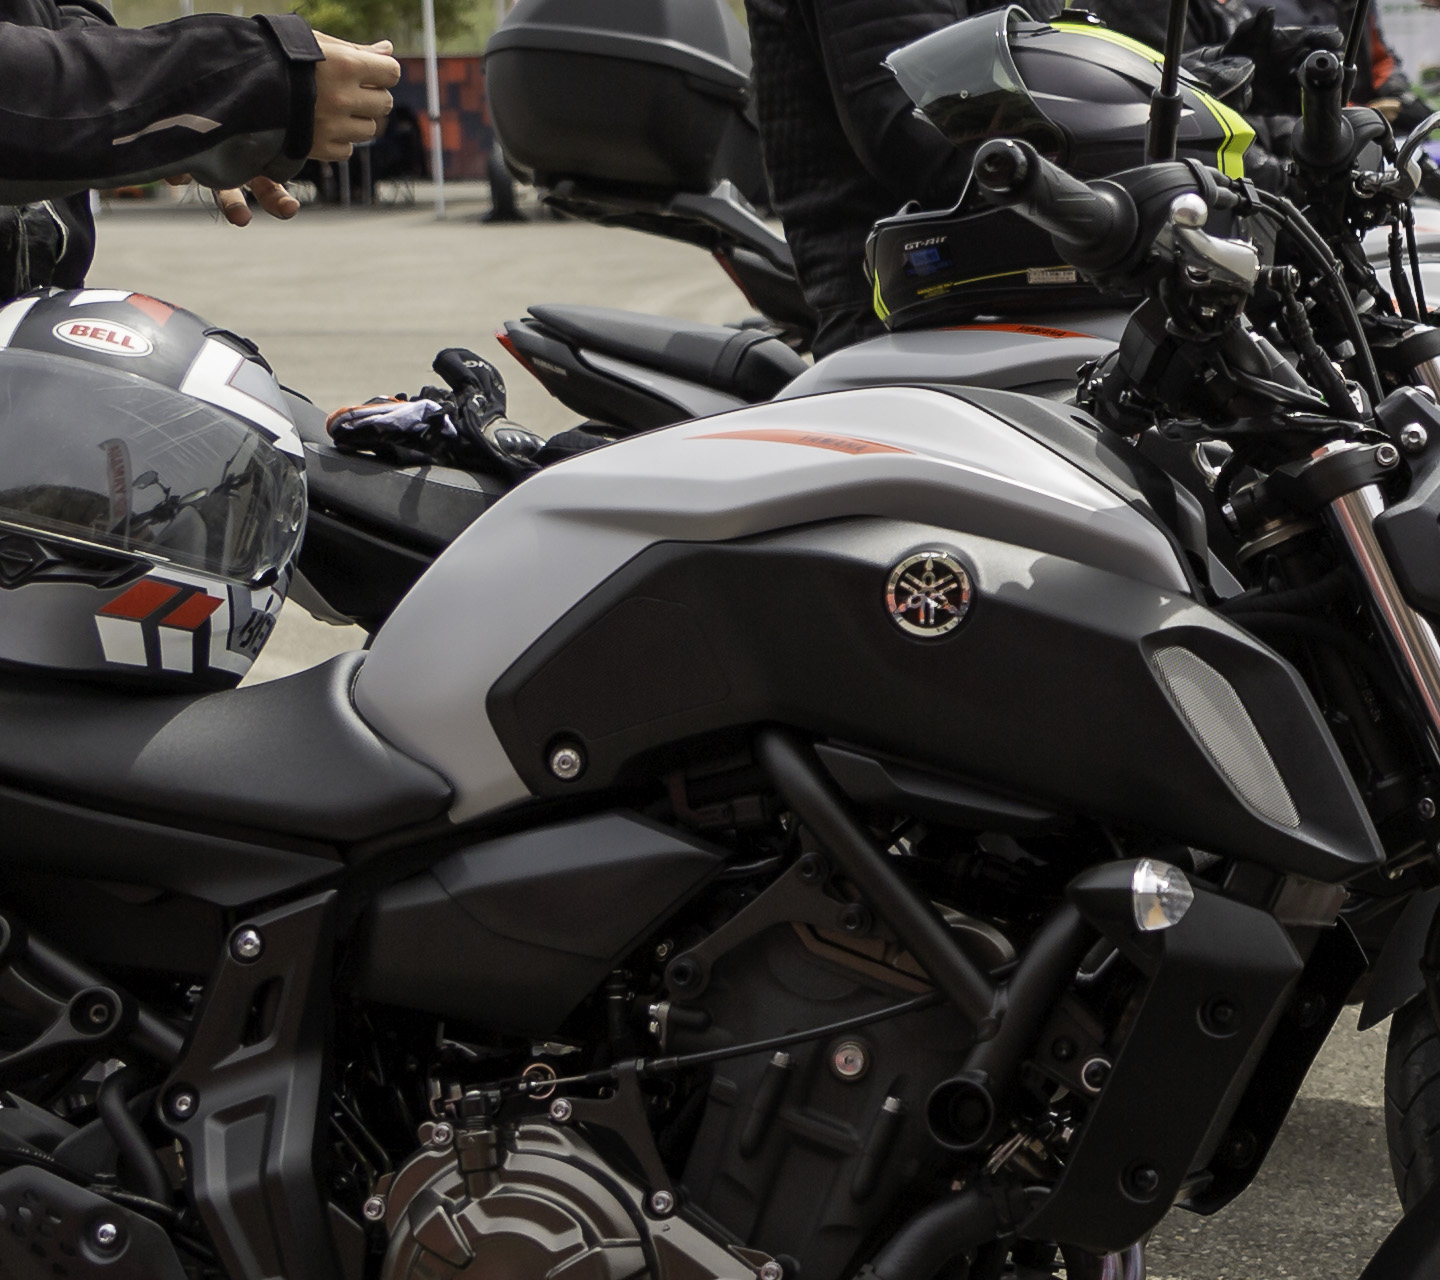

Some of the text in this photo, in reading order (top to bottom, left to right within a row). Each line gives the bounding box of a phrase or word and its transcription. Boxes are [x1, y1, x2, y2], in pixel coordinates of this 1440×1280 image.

[904, 236, 948, 251] GT-Air
[68, 323, 138, 351] BELL
[798, 434, 868, 454] YAMAHA
